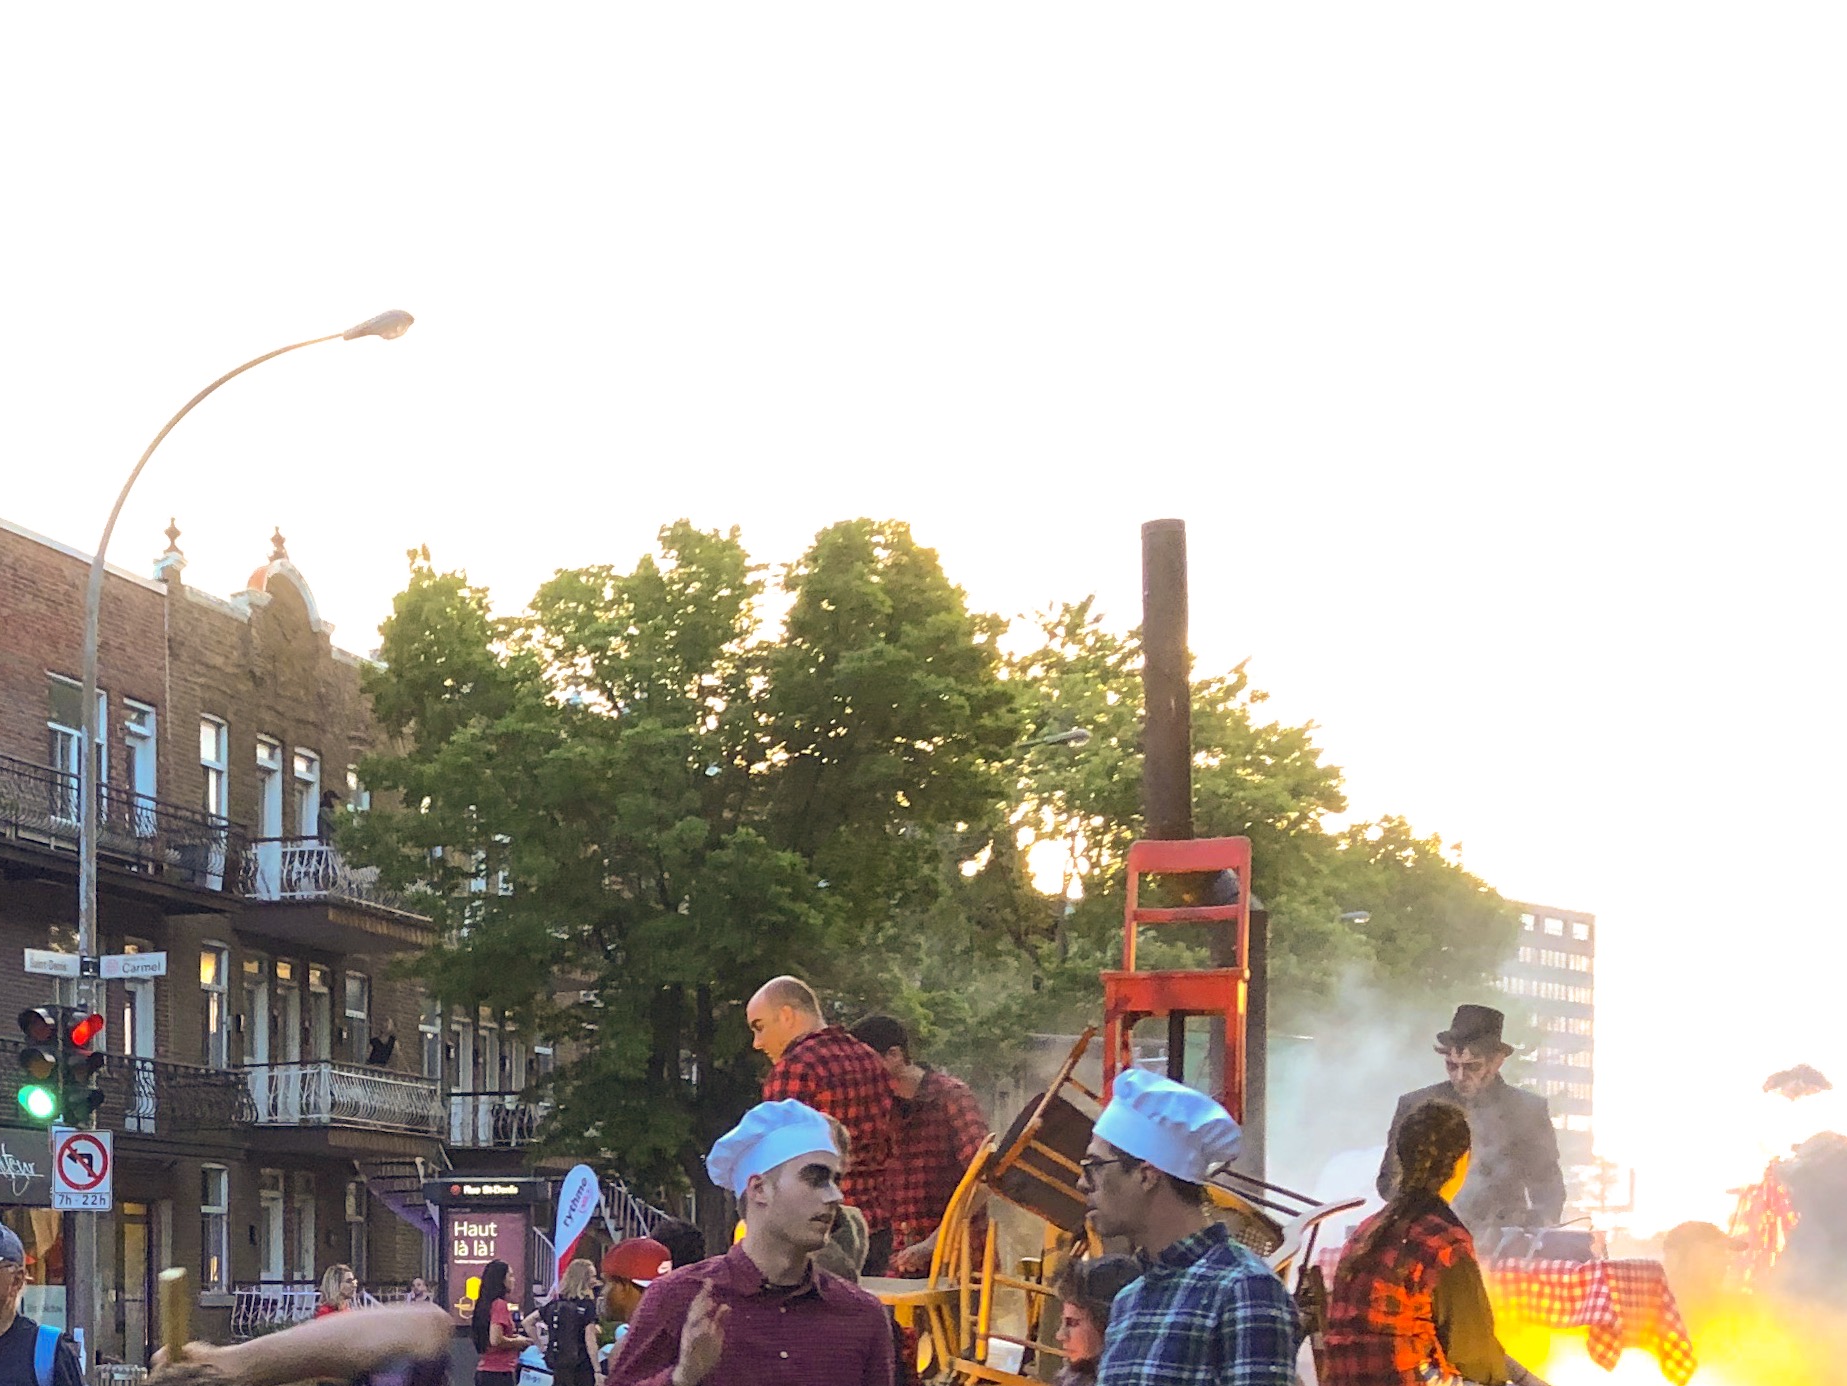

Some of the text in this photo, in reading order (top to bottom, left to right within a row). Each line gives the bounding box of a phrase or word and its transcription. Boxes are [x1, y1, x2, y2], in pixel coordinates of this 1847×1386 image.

[122, 960, 161, 974] Carmel
[59, 1194, 72, 1206] 7h
[82, 1194, 106, 1206] 22h
[563, 1177, 588, 1227] rythme
[454, 1221, 498, 1237] Haut
[454, 1240, 469, 1256] là
